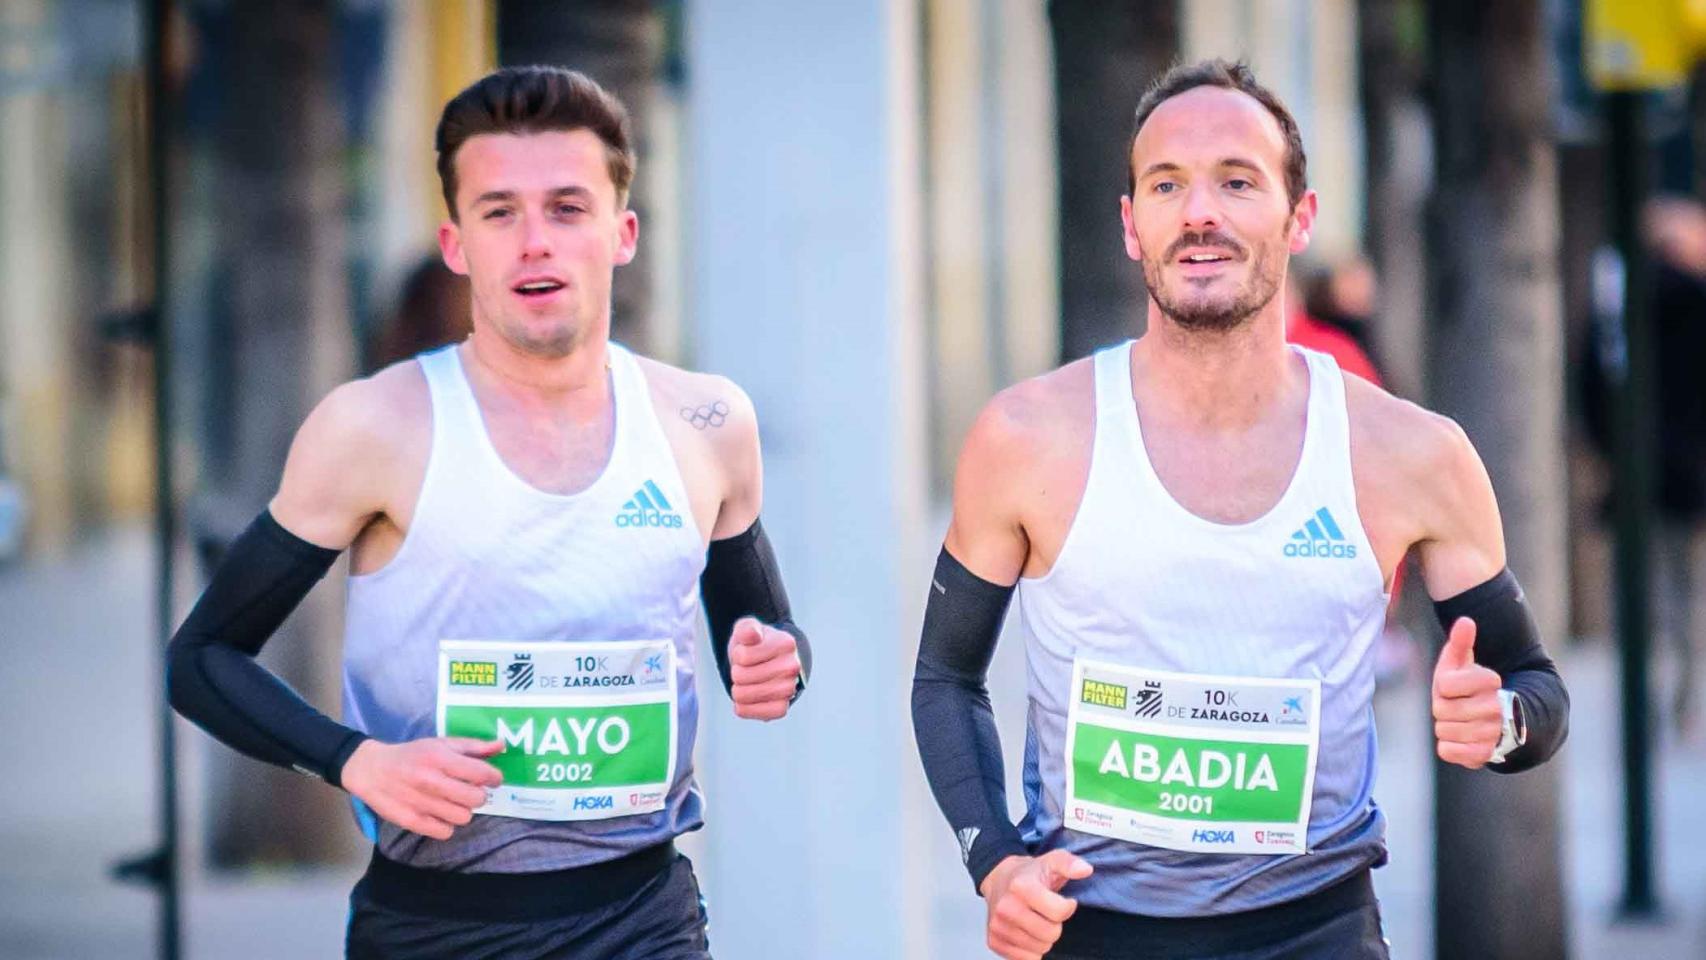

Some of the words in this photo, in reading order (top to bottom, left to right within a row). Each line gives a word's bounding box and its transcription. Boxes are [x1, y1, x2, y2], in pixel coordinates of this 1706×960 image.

[616, 508, 682, 528] adidas
[1283, 540, 1357, 559] adidas
[451, 662, 496, 674] MANN
[575, 656, 609, 672] 10K
[451, 673, 496, 685] FILTER
[539, 676, 559, 687] DE
[563, 674, 635, 687] ZARAGOZA
[1083, 680, 1127, 698] MANN
[1082, 691, 1125, 709] FILTER
[1204, 690, 1240, 707] 10K
[1167, 707, 1187, 718] DE
[1190, 708, 1269, 724] ZARAGOZA
[496, 716, 631, 756] MAYO
[536, 763, 593, 782] 2002
[1098, 739, 1279, 792] ABADIA
[573, 795, 613, 810] HOKA
[1158, 791, 1213, 814] 2001
[1192, 829, 1235, 843] HOKA
